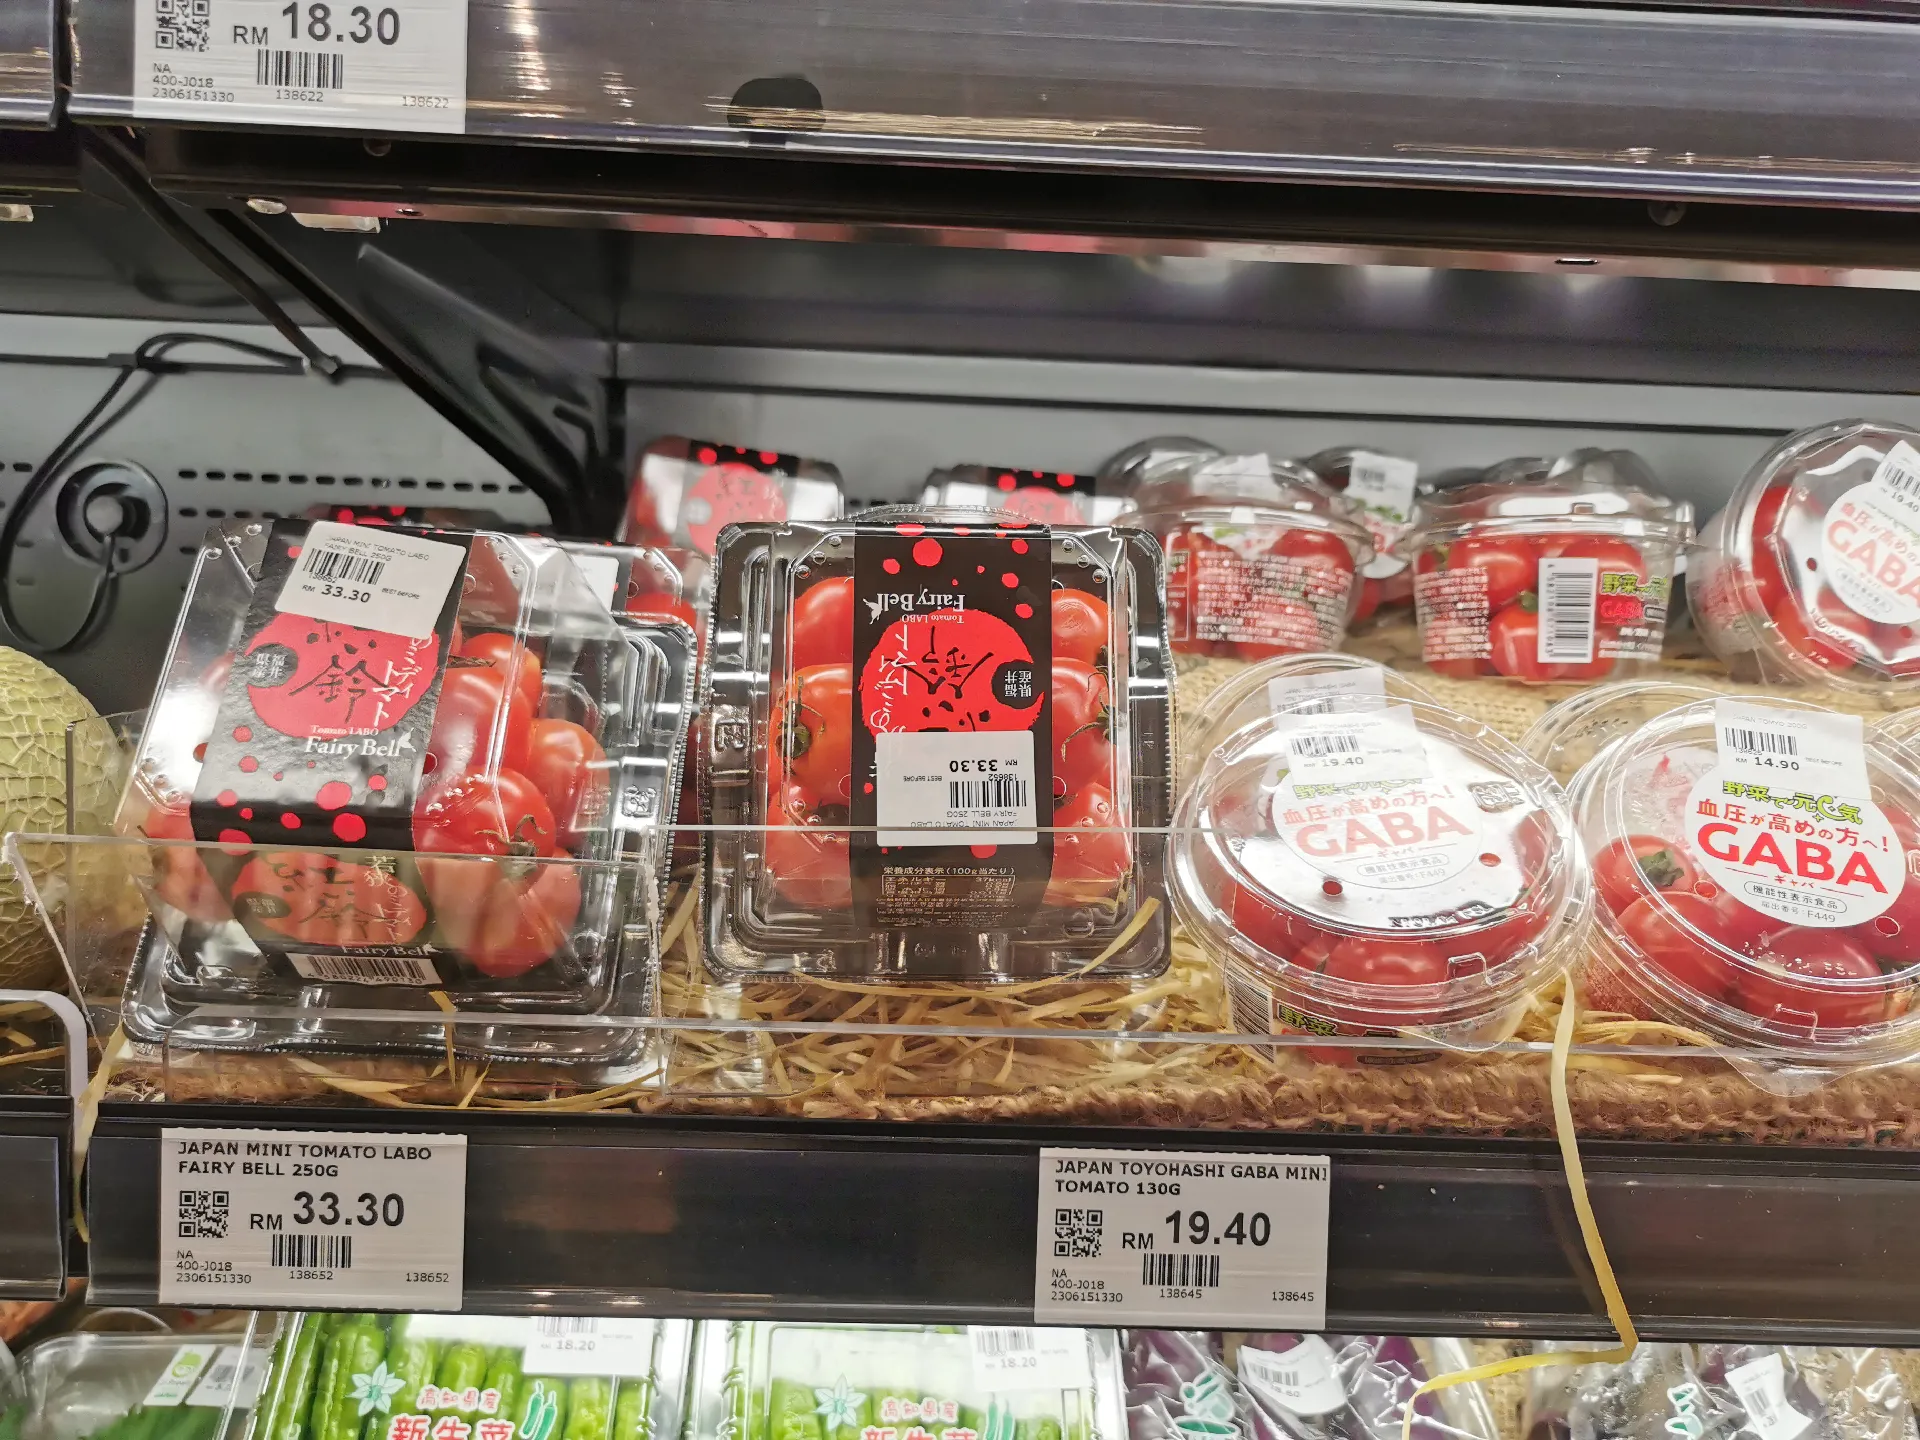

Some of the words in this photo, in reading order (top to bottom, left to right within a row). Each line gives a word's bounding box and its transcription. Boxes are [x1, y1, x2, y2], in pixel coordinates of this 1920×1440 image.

[233, 25, 269, 45] RM
[282, 1, 401, 46] 18.30
[152, 62, 172, 74] NA
[152, 75, 214, 88] 400-J018
[152, 88, 235, 103] 2306151330
[275, 89, 324, 102] 138622
[401, 95, 449, 109] 138622
[302, 584, 315, 592] RM
[321, 585, 371, 603] 33.30
[917, 588, 965, 612] Fairy
[877, 593, 914, 612] Bell
[901, 614, 928, 623] LABO
[930, 615, 964, 623] Tomato
[311, 725, 348, 736] Tomato
[349, 726, 379, 737] LABO
[305, 736, 359, 759] Fairy
[362, 738, 402, 757] Bell
[949, 759, 998, 773] 33.30
[1322, 756, 1364, 767] 19.40
[1754, 757, 1800, 771] 14.90
[988, 773, 1018, 782] 138652
[1296, 806, 1474, 857] GABA
[1696, 798, 1889, 853] 血圧が高めの方へ!
[1697, 822, 1889, 894] GABA
[1774, 874, 1815, 889] ギャバ
[1753, 885, 1839, 910] 機能性表示食品
[177, 1141, 239, 1156] JAPAN
[246, 1142, 292, 1157] MINI
[299, 1144, 377, 1159] TOMATO
[383, 1146, 432, 1160] LABO
[178, 1161, 235, 1175] FAIRY
[242, 1162, 285, 1176] BELL
[292, 1163, 339, 1177] 250G
[1055, 1160, 1113, 1175] JAPAN
[1120, 1161, 1225, 1178] TOYOHASHI
[1231, 1164, 1279, 1180] GABA
[1285, 1167, 1328, 1181] MINI
[1055, 1179, 1130, 1194] TOMATO
[1136, 1182, 1181, 1196] 130G
[250, 1213, 283, 1231] RM
[293, 1191, 405, 1227] 33.30
[1122, 1233, 1154, 1250] RM
[1165, 1210, 1272, 1247] 19.40
[176, 1250, 194, 1259] NA
[176, 1261, 233, 1272] 400-J018
[1051, 1268, 1068, 1278] NA
[176, 1272, 252, 1284] 2306151330
[289, 1270, 334, 1280] 138652
[405, 1272, 450, 1283] 138652
[1051, 1279, 1105, 1290] 400-J018
[1051, 1291, 1123, 1303] 2306151330
[1159, 1288, 1203, 1299] 138645
[1272, 1291, 1315, 1303] 138645
[556, 1340, 596, 1351] 18.20
[1001, 1356, 1037, 1368] 18.20
